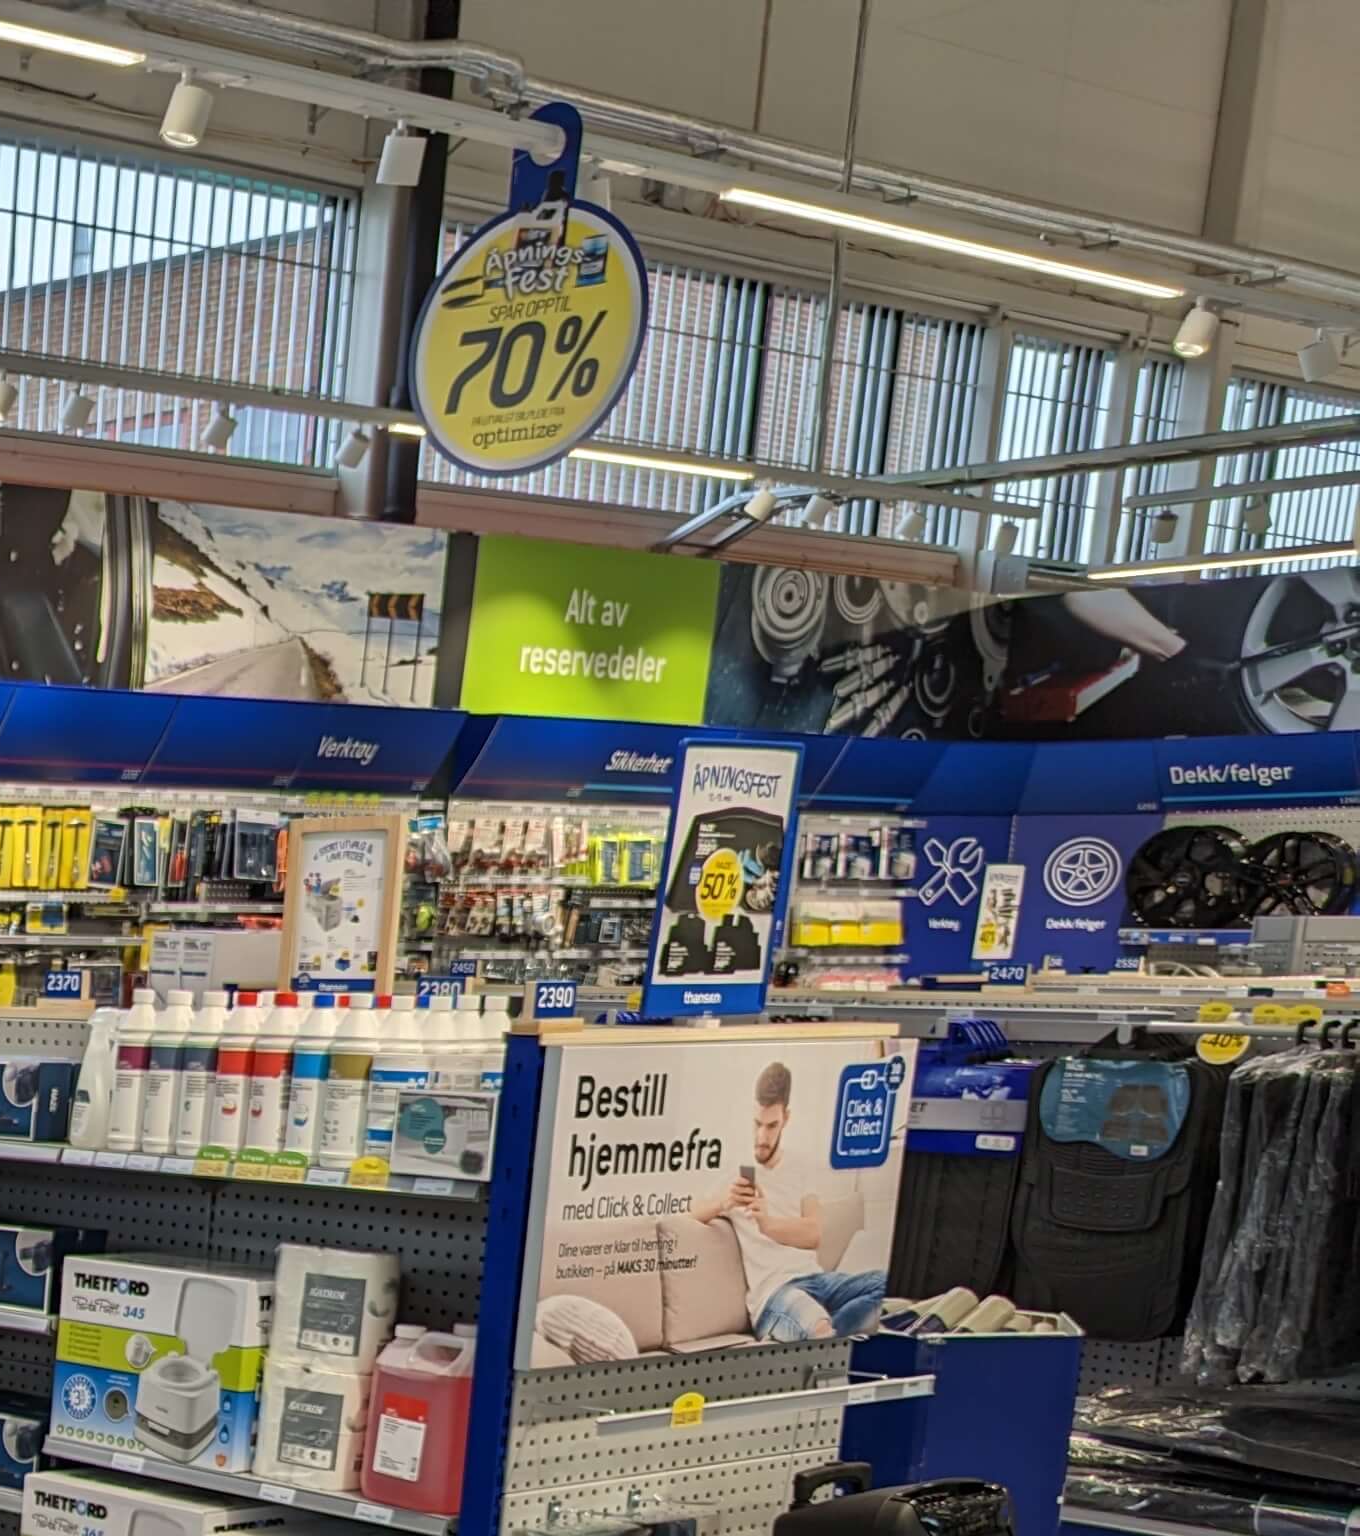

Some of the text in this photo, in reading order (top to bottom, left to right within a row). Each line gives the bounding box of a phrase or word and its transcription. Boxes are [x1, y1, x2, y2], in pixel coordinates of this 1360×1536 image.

[472, 424, 563, 449] optimize
[564, 588, 628, 628] Alt av
[518, 645, 667, 685] reservedeler
[317, 736, 379, 766] Verktøy
[605, 751, 674, 774] Sikkerhet
[692, 764, 781, 799] ÅPNINGSFEST
[1169, 761, 1294, 787] Dekk/felger
[47, 974, 79, 993] 2370
[991, 967, 1024, 980] 2470
[419, 982, 461, 997] 2380
[538, 987, 574, 1008] 2390
[684, 991, 721, 1005] thansen
[574, 1073, 668, 1119] Bestill
[847, 1098, 883, 1118] Click &
[844, 1119, 881, 1137] Collect
[568, 1127, 722, 1191] hjemmefra
[562, 1192, 692, 1221] med Click & Collect
[558, 1243, 578, 1258] Dine
[603, 1243, 612, 1254] er
[614, 1240, 631, 1254] klar
[641, 1237, 673, 1255] henting
[555, 1255, 698, 1280] butikken på MAKS 30 minutter!
[74, 1272, 149, 1297] THETFORD
[123, 1305, 145, 1320] 345
[34, 1491, 108, 1519] THETFORD
